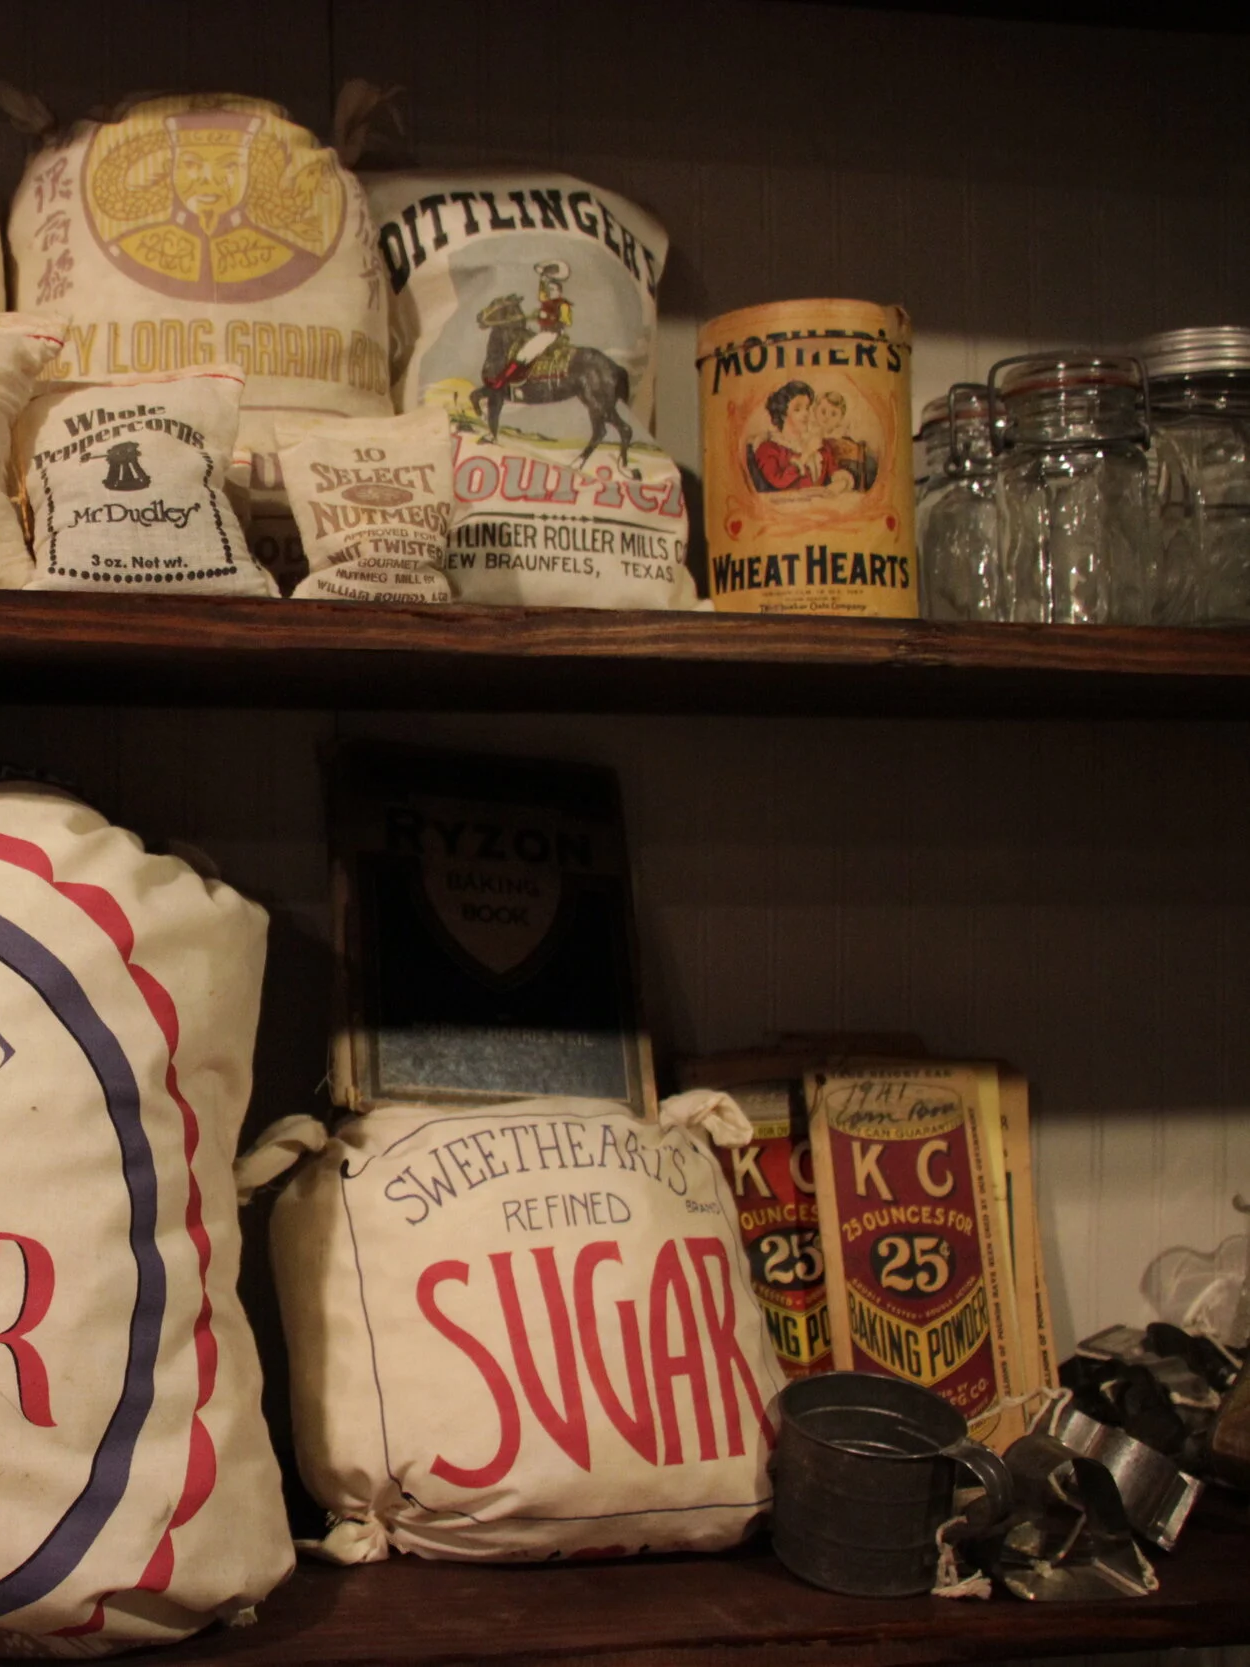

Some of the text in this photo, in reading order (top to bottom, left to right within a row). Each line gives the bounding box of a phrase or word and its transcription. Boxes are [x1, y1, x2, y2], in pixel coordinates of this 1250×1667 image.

[107, 318, 218, 374] LONG
[224, 320, 344, 383] GRAIN
[712, 327, 903, 396] MOTHER'S
[63, 404, 167, 438] Whole
[32, 418, 206, 471] Peppercorns
[354, 448, 387, 463] 10
[309, 462, 436, 494] SELECT
[308, 501, 450, 541] NUTMEGS
[344, 528, 409, 542] APPROVED
[91, 553, 101, 568] 3
[369, 537, 443, 562] TWISTED
[544, 525, 615, 554] ROLLER
[621, 531, 669, 561] MILLS
[357, 558, 419, 571] GOURMET
[444, 552, 477, 569] EW
[485, 552, 601, 579] BRAUNFELS,
[712, 544, 910, 596] WHEAT HEARTS
[385, 805, 594, 867] RYZON
[445, 871, 541, 898] BAKING
[461, 902, 531, 927] BOOK
[730, 1146, 772, 1198] K
[850, 1139, 955, 1201] K C
[502, 1191, 632, 1234] REFINED
[740, 1203, 820, 1230] OUNCES
[841, 1204, 974, 1243] 25 OUNCES FOR
[850, 1290, 921, 1385] BAKING
[927, 1285, 990, 1378] POWDER
[415, 1236, 779, 1489] SUGAR
